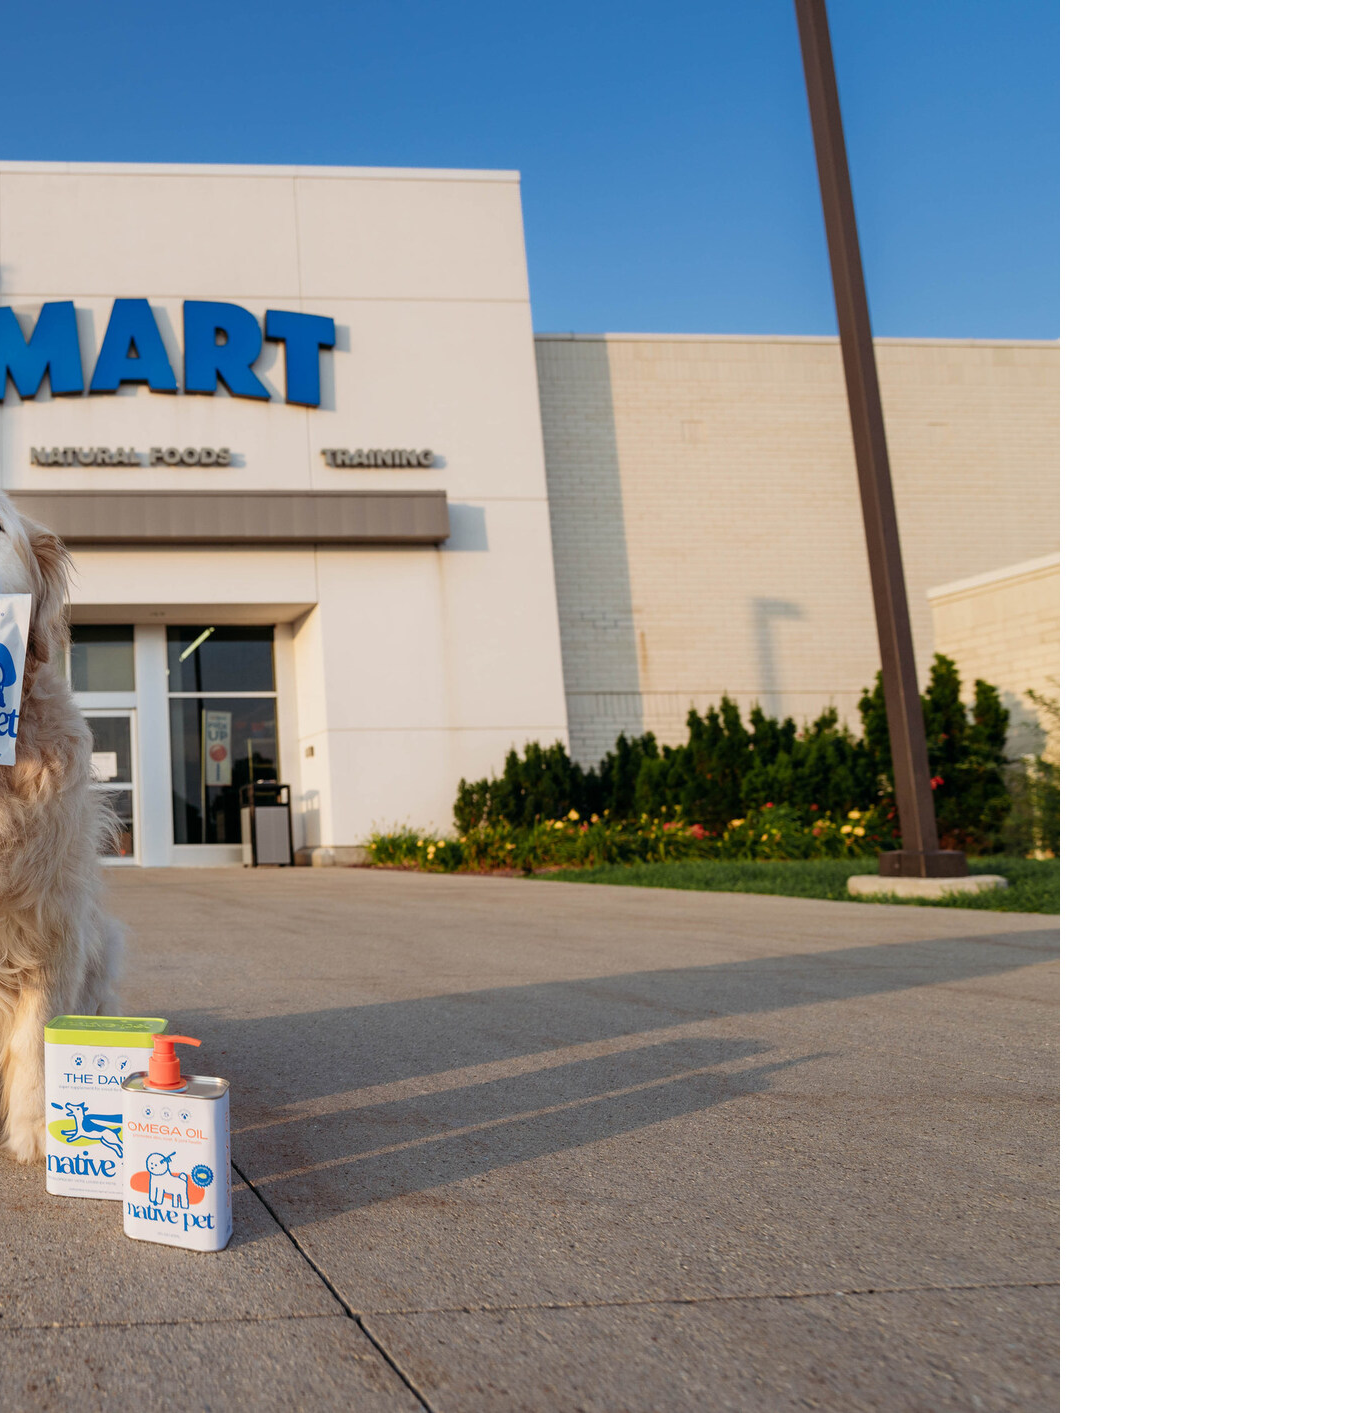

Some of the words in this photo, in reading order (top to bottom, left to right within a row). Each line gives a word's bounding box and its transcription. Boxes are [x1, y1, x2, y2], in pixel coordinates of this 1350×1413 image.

[29, 446, 141, 467] NATURAL
[149, 446, 232, 467] FOODS
[321, 448, 436, 468] TRAINING
[207, 730, 228, 741] UP
[63, 1073, 93, 1084] THE
[127, 1121, 182, 1137] OMEGA
[186, 1128, 209, 1140] OIL
[48, 1151, 116, 1177] native
[128, 1202, 178, 1224] native
[183, 1212, 215, 1232] pet
